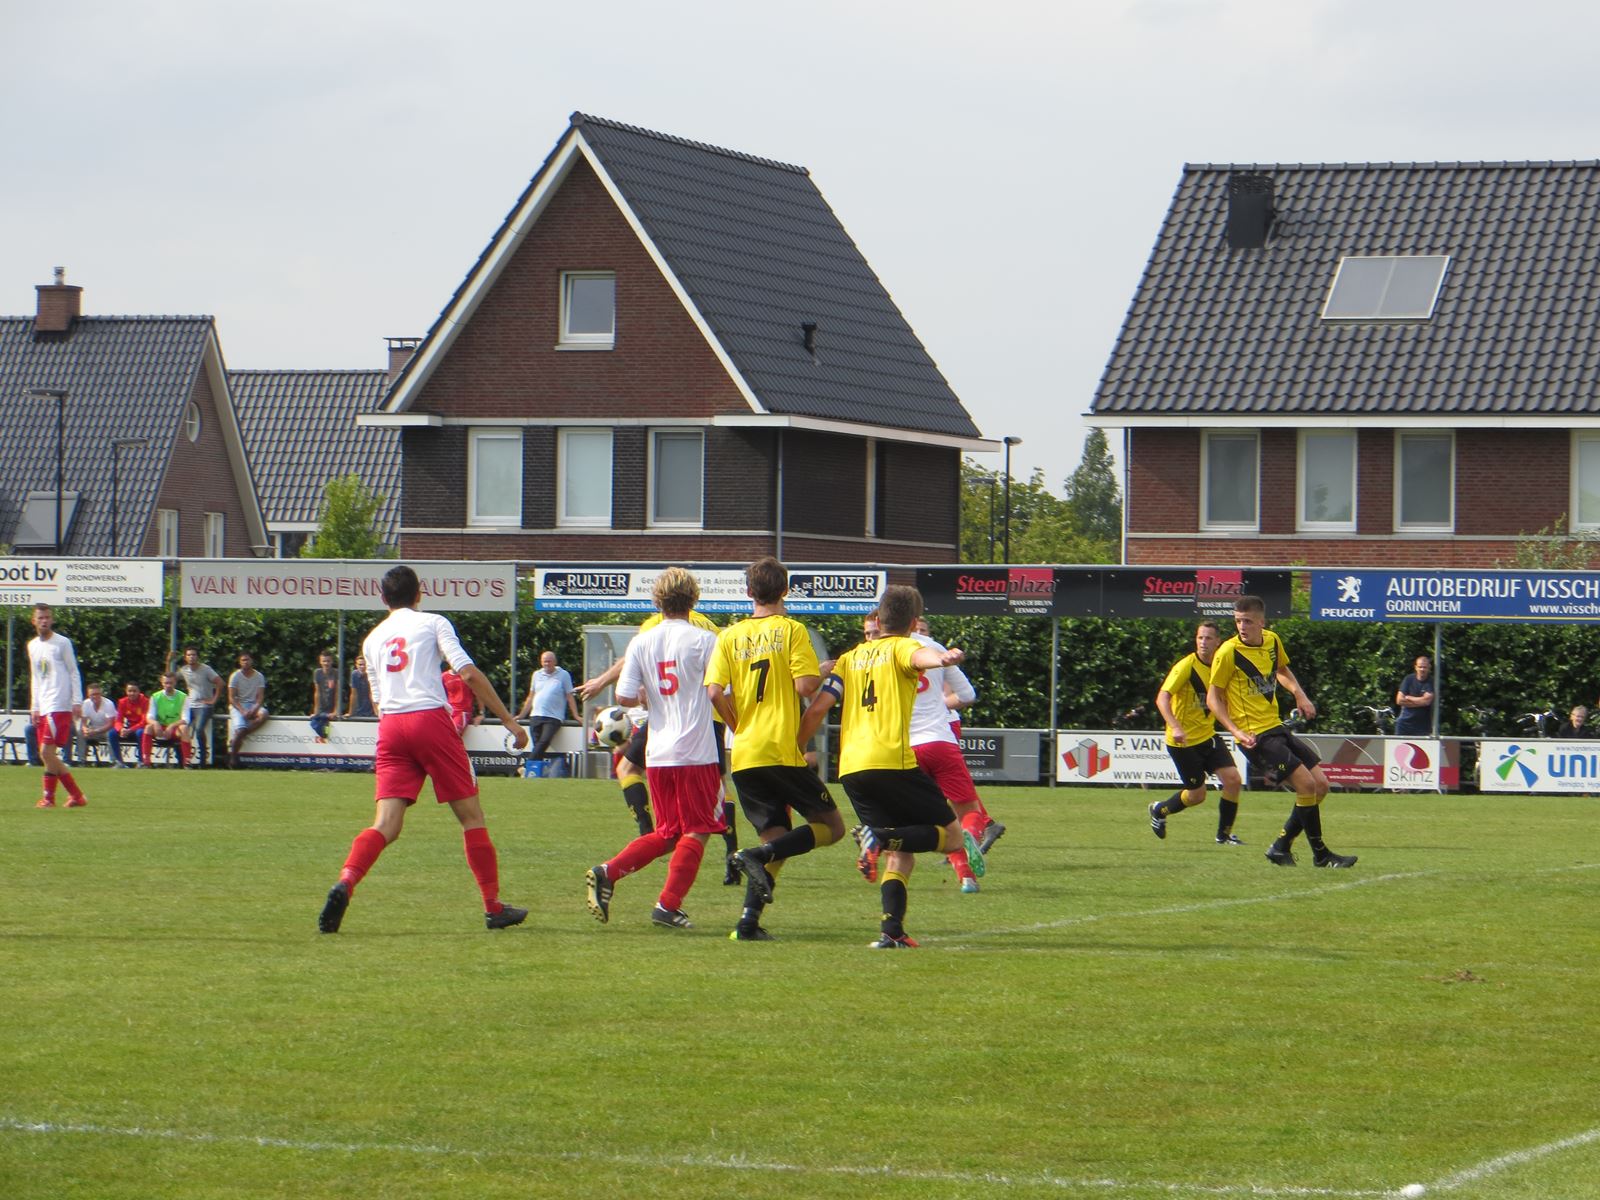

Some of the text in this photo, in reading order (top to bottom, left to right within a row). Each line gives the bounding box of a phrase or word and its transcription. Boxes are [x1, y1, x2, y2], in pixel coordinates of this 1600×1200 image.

[34, 562, 58, 581] bv
[66, 563, 120, 571] WEGENBOUW
[66, 574, 127, 582] GRONDWERKEN
[190, 575, 237, 595] VAN
[247, 576, 384, 597] NOORDENN
[567, 574, 627, 588] RUIJTER
[813, 576, 875, 590] RUIJTER
[956, 575, 1057, 595] Steenplaza
[1143, 576, 1245, 596] Steenplaza
[1386, 577, 1599, 599] AUTOBEDRIJF VISSCH
[0, 594, 31, 603] 51557
[1386, 600, 1461, 612] GORINCHEM
[1321, 608, 1376, 618] PEUGEOT
[386, 637, 409, 673] 3
[657, 660, 679, 696] 5
[750, 658, 771, 704] 7
[861, 672, 878, 712] 4
[1114, 738, 1162, 751] P. VAN
[1389, 766, 1433, 783] Skinz
